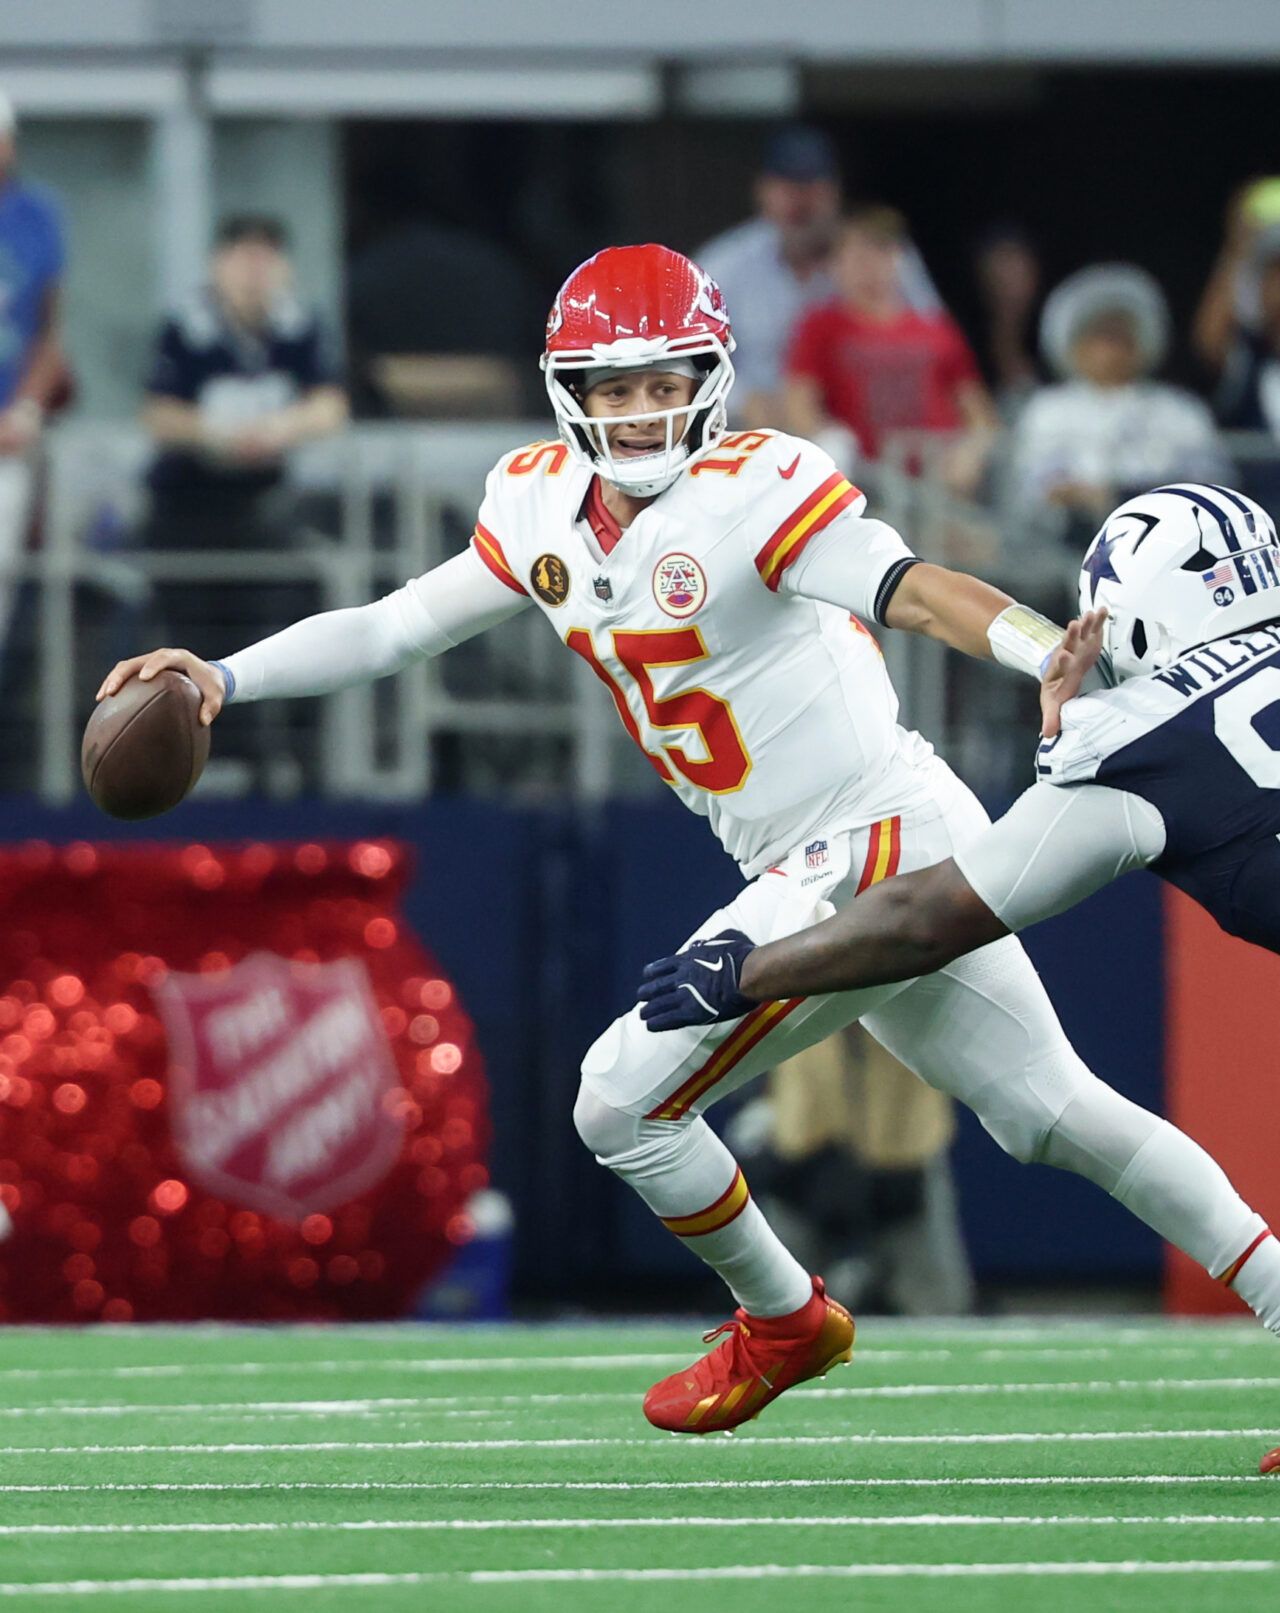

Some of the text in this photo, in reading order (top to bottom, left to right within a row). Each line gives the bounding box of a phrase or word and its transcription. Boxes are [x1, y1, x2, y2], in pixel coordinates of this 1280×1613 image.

[689, 431, 775, 477] 15
[1213, 588, 1234, 605] 94
[565, 625, 752, 794] 15
